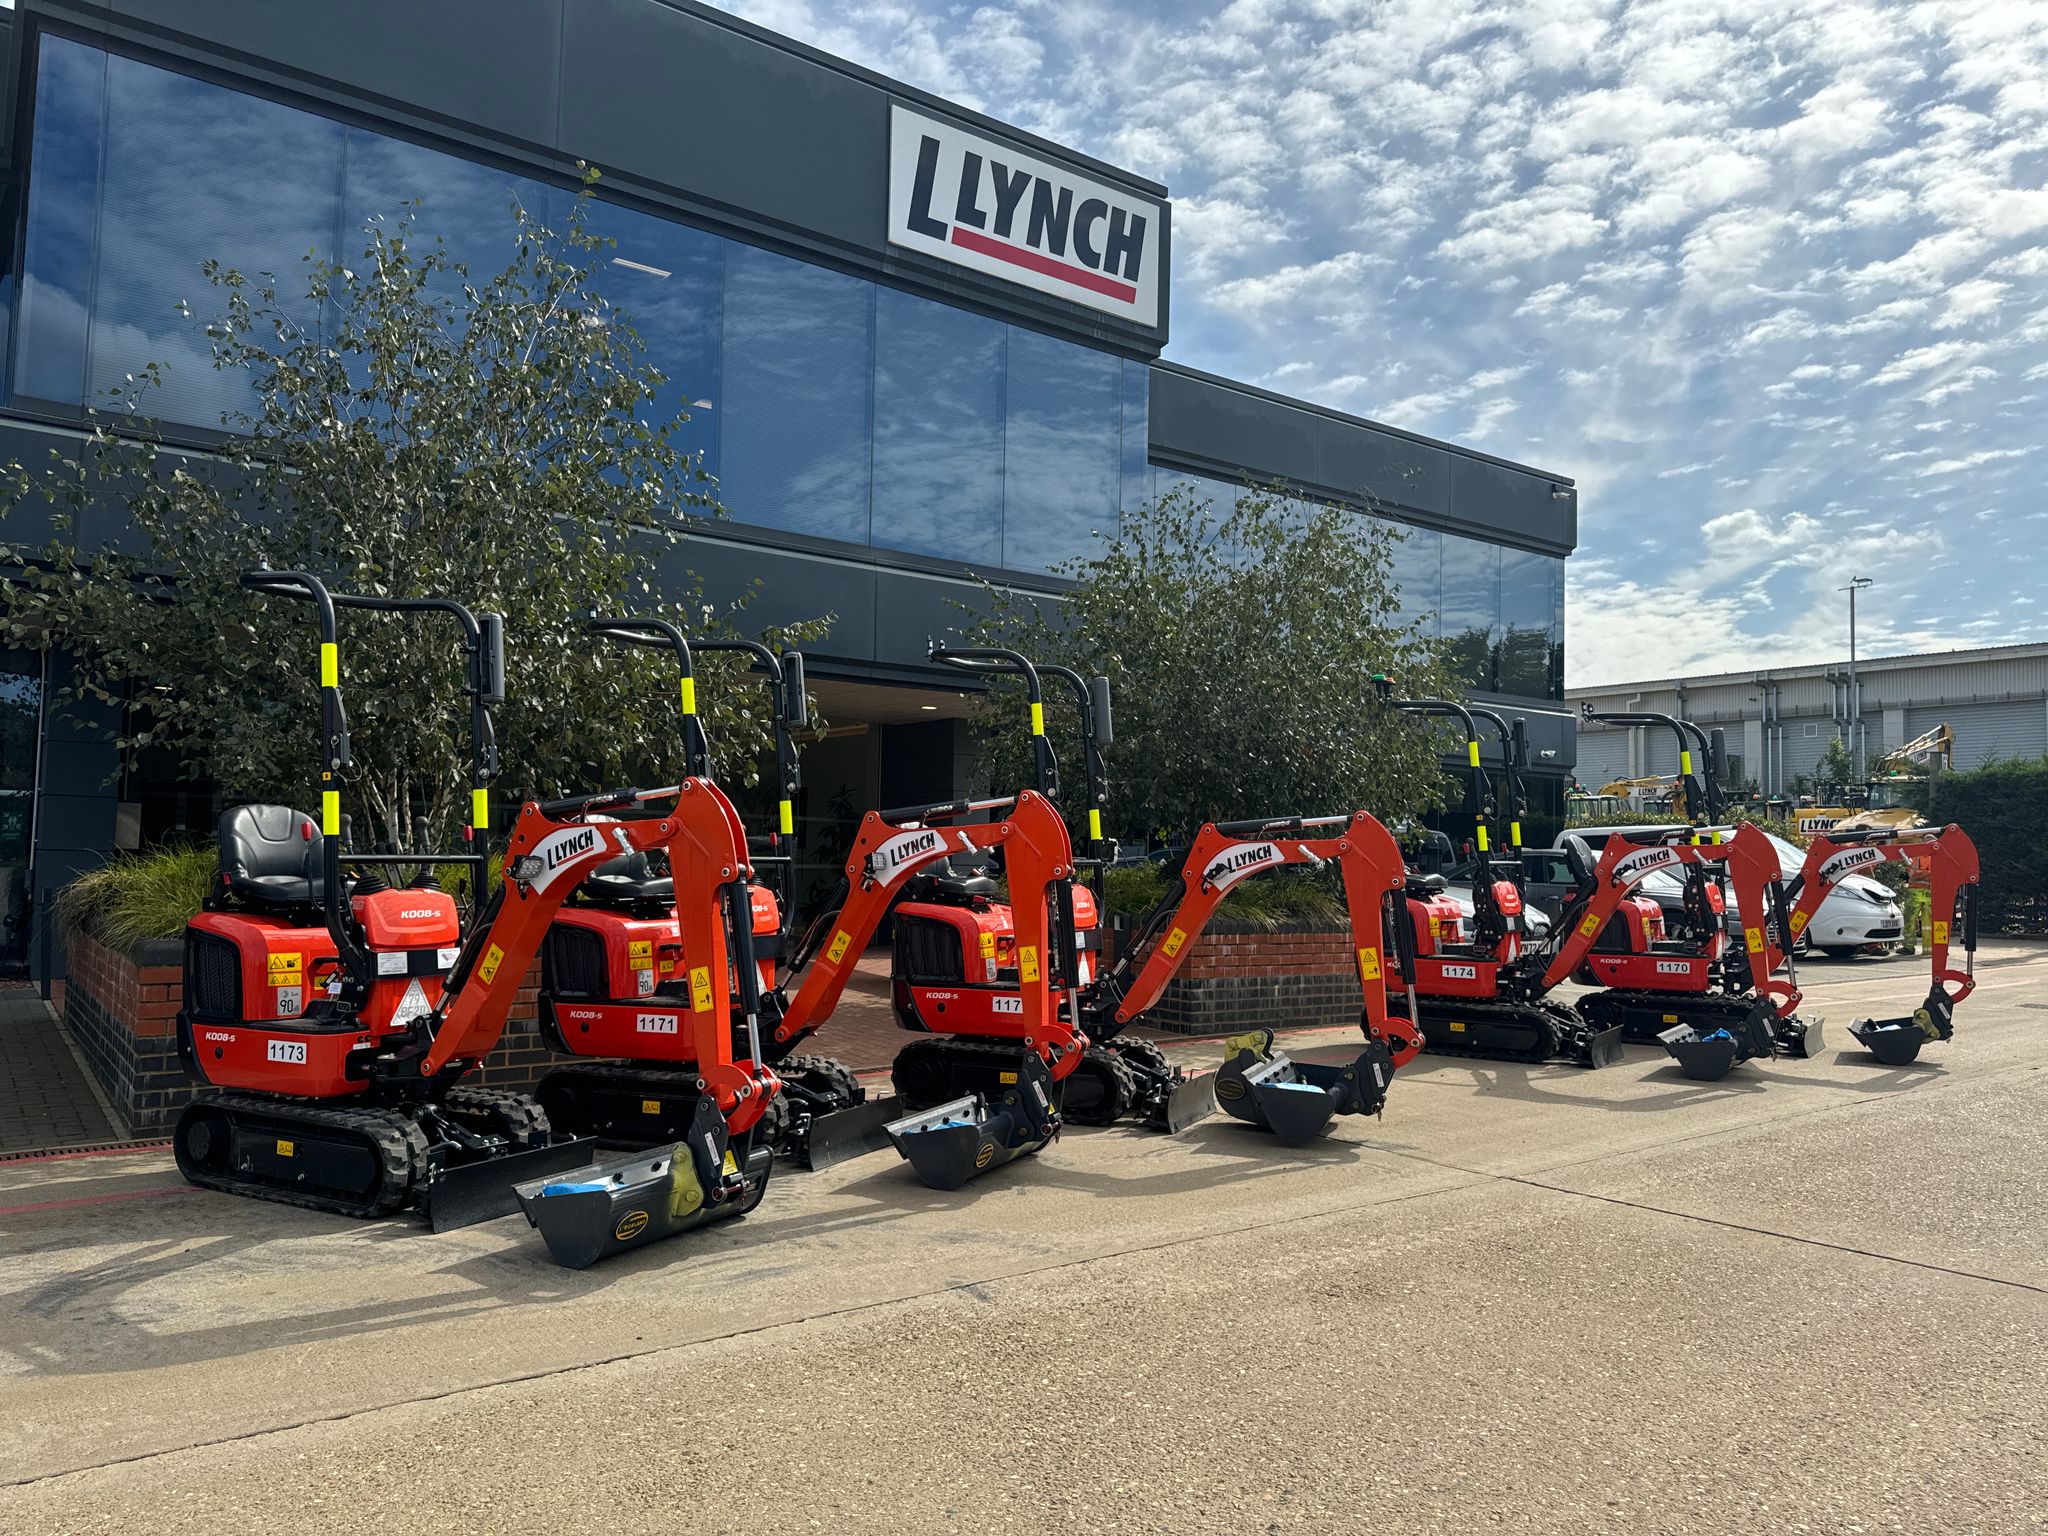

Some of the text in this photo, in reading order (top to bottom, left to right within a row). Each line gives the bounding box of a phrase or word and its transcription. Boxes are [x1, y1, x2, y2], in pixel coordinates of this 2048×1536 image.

[955, 150, 1147, 283] LYNCH
[1808, 819, 1841, 830] LYNC
[555, 829, 594, 861] LYNCH
[898, 832, 935, 859] LYNCH
[1235, 845, 1272, 867] LYNCH
[1639, 849, 1670, 867] LYNCH
[1844, 849, 1876, 866] LYNCH
[1444, 967, 1474, 977] 1174
[1659, 963, 1688, 972] 1170
[280, 999, 294, 1013] 90
[409, 993, 420, 1005] 79
[995, 999, 1021, 1011] 117
[639, 1017, 674, 1031] 1171
[270, 1043, 304, 1061] 1173
